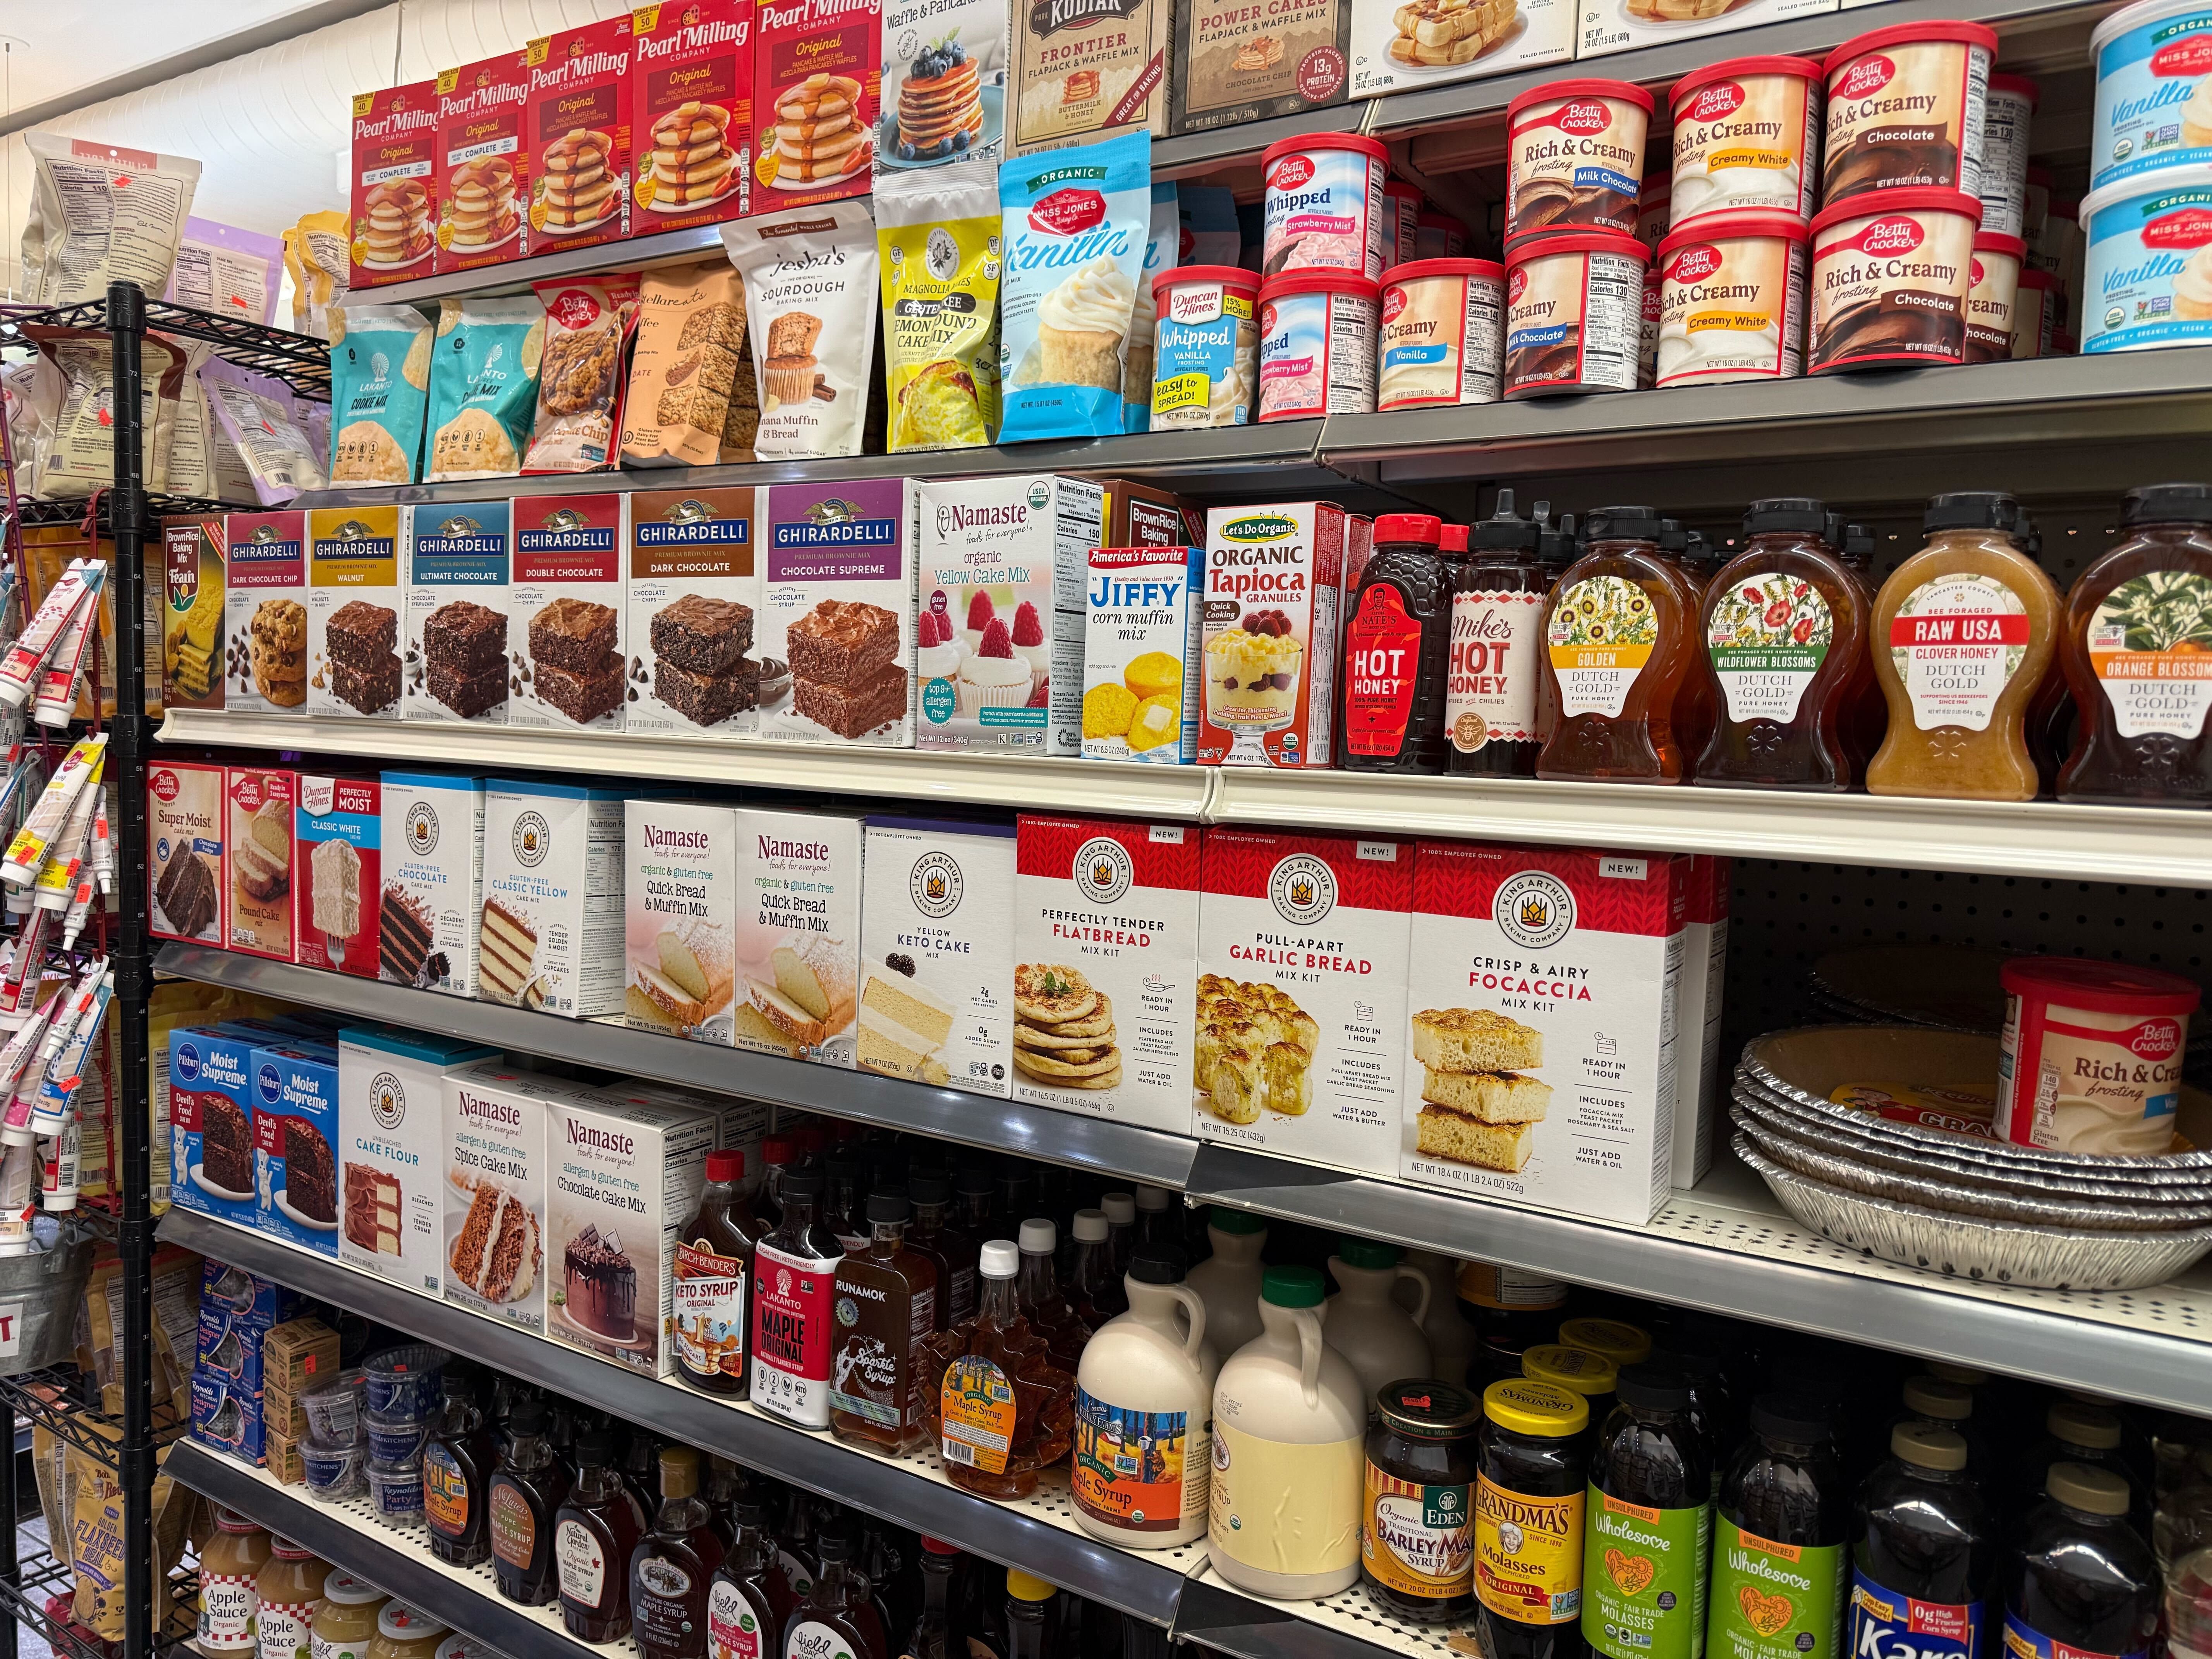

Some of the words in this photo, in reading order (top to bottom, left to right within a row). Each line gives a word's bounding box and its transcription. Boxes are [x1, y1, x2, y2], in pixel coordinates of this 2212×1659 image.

[641, 19, 650, 27] 50
[637, 34, 681, 61] Pearl
[683, 21, 750, 47] Milling
[1041, 33, 1127, 64] FRONTIER
[670, 47, 710, 62] COMPANY
[1029, 60, 1071, 78] FLAPJACK
[1073, 58, 1080, 67] &
[1081, 51, 1117, 66] WAFFLE
[1121, 46, 1139, 58] MIX
[670, 64, 712, 85] Original
[1314, 58, 1331, 75] 13g
[1225, 74, 1270, 89] CHOCOLATE
[1273, 71, 1291, 81] CHIP
[1307, 74, 1334, 86] PROTEIN
[1115, 97, 1134, 122] GREAT
[1139, 64, 1161, 91] BAKING
[2111, 80, 2194, 127] Vanilla
[1525, 144, 1558, 163] Rich
[1562, 140, 1576, 154] &
[1580, 140, 1635, 168] Creamy
[1041, 169, 1094, 184] ORGANIC
[1531, 161, 1573, 178] frosting
[1578, 170, 1599, 181] Milk
[1601, 172, 1637, 193] Chocolate
[1267, 188, 1331, 215] Whipped
[1287, 220, 1332, 231] Strawberry
[1334, 221, 1352, 230] Mist
[1592, 256, 1614, 266] Nutrition
[1618, 259, 1629, 269] Facts
[761, 281, 845, 302] SOURDOUGH
[1590, 285, 1613, 294] Calories
[1615, 286, 1627, 296] 130
[1173, 292, 1218, 309] Duncan
[1895, 294, 1954, 311] Chocolate
[1174, 352, 1211, 360] VANILLA
[1156, 378, 1183, 397] easy
[1186, 378, 1197, 387] to
[1158, 392, 1194, 407] SPREAD!
[772, 429, 798, 438] Bread
[952, 503, 1027, 531] Namaste
[234, 545, 297, 558] GHIRARDELLI
[964, 551, 1001, 565] organic
[1091, 550, 1139, 563] America's
[1141, 550, 1183, 562] Favorite
[1212, 546, 1304, 566] ORGANIC
[781, 566, 835, 575] CHOCOLATE
[839, 565, 884, 574] SUPREME
[935, 569, 970, 585] Yellow
[973, 569, 1005, 582] Cake
[1008, 567, 1030, 582] Mix
[1209, 567, 1305, 599] Tapioca
[1246, 593, 1301, 603] GRANULES
[1206, 610, 1235, 620] Cooking
[1211, 603, 1230, 612] Quick
[1093, 611, 1122, 624] corn
[1126, 609, 1174, 624] muffin
[1118, 625, 1146, 641] mix
[1915, 622, 1955, 641] RAW
[1962, 620, 2002, 640] USA
[1577, 653, 1616, 666] GOLDEN
[1916, 649, 1956, 659] CLOVER
[1960, 648, 1998, 659] HONEY
[1355, 650, 1405, 676] HOT
[1717, 657, 1767, 668] WILDFLOWER
[1771, 657, 1816, 668] BLOSSOMS
[1354, 679, 1401, 695] HONEY
[340, 788, 372, 798] PERFECTLY
[339, 797, 372, 811] MOIST
[158, 810, 185, 827] Super
[186, 812, 211, 828] Moist
[312, 821, 337, 832] CLASSIC
[339, 824, 361, 834] WHITE
[1156, 830, 1178, 839] NEW!
[398, 869, 447, 884] CHOCOLATE
[647, 880, 673, 895] Quick
[676, 884, 706, 899] Bread
[645, 898, 651, 910] &
[654, 899, 687, 914] Muffin
[689, 902, 708, 917] Mix
[549, 930, 568, 938] TENDER
[917, 927, 950, 936] YELLOW
[1053, 924, 1151, 948] FLATBREAD
[548, 937, 568, 945] GOLDEN
[898, 934, 929, 948] KETO
[935, 939, 970, 954] CAKE
[1256, 933, 1344, 952] PULL-APART
[1230, 945, 1297, 966] GARLIC
[1306, 953, 1372, 975] BREAD
[544, 965, 569, 973] CUPCAKES
[1469, 972, 1592, 1002] FOCACCIA
[210, 1051, 238, 1069] Moist
[2074, 1058, 2128, 1082] Rich
[2085, 1081, 2144, 1100] frosting
[1568, 1119, 1600, 1128] ROSEMARY
[356, 1138, 381, 1156] CAKE
[384, 1147, 419, 1166] FLOUR
[558, 1176, 599, 1201] Chocolate
[602, 1190, 626, 1207] Cake
[628, 1198, 646, 1214] Mix
[413, 1219, 431, 1228] TENDER
[414, 1224, 431, 1234] CRUMB
[678, 1248, 699, 1263] BIRCH
[699, 1255, 736, 1274] BENDERS
[836, 1280, 886, 1302] RUNAMOK
[766, 1291, 801, 1309] LAKANTO
[954, 1396, 977, 1413] Maple
[979, 1404, 1002, 1420] Syrup
[386, 1495, 411, 1505] Party
[1427, 1509, 1465, 1525] EDEN
[1607, 1500, 1654, 1519] UNSULPHURED
[1595, 1512, 1670, 1550] Wholesome
[1408, 1553, 1444, 1568] SYRUP
[1482, 1543, 1546, 1575] Molasses
[208, 1590, 246, 1604] Apple
[210, 1605, 247, 1618] Sauce
[641, 1600, 661, 1613] MAPLE
[664, 1606, 687, 1618] SYRUP
[1601, 1605, 1654, 1630] MOLASSES
